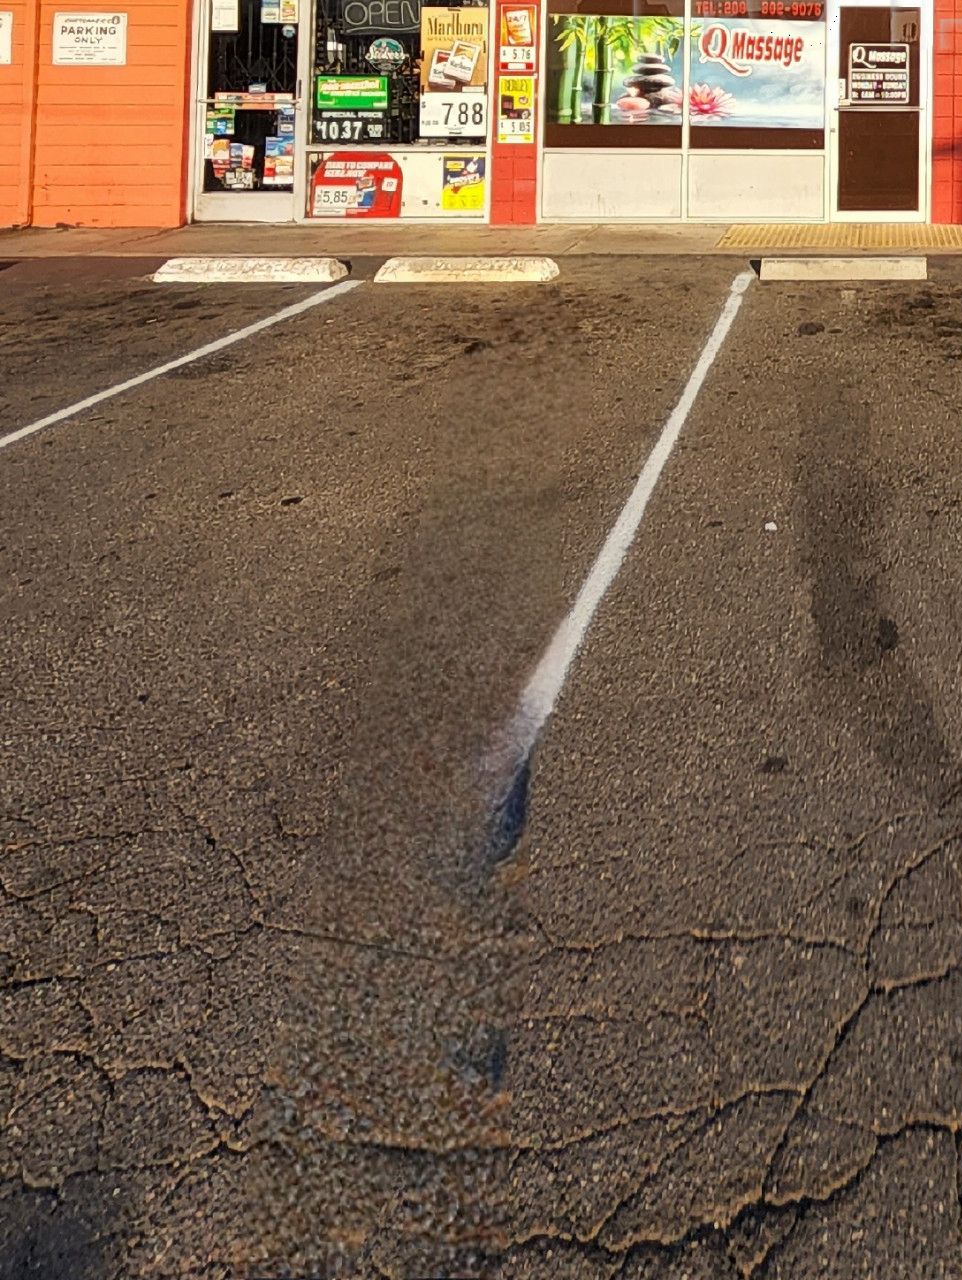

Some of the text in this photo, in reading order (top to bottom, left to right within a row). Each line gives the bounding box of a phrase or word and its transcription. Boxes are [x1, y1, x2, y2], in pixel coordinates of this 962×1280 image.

[344, 0, 421, 26] OPEN
[428, 13, 484, 36] Marlboro
[60, 26, 117, 36] PARKING
[74, 36, 104, 45] ONLY
[701, 26, 802, 74] Q Massage
[852, 45, 907, 69] Q Massage
